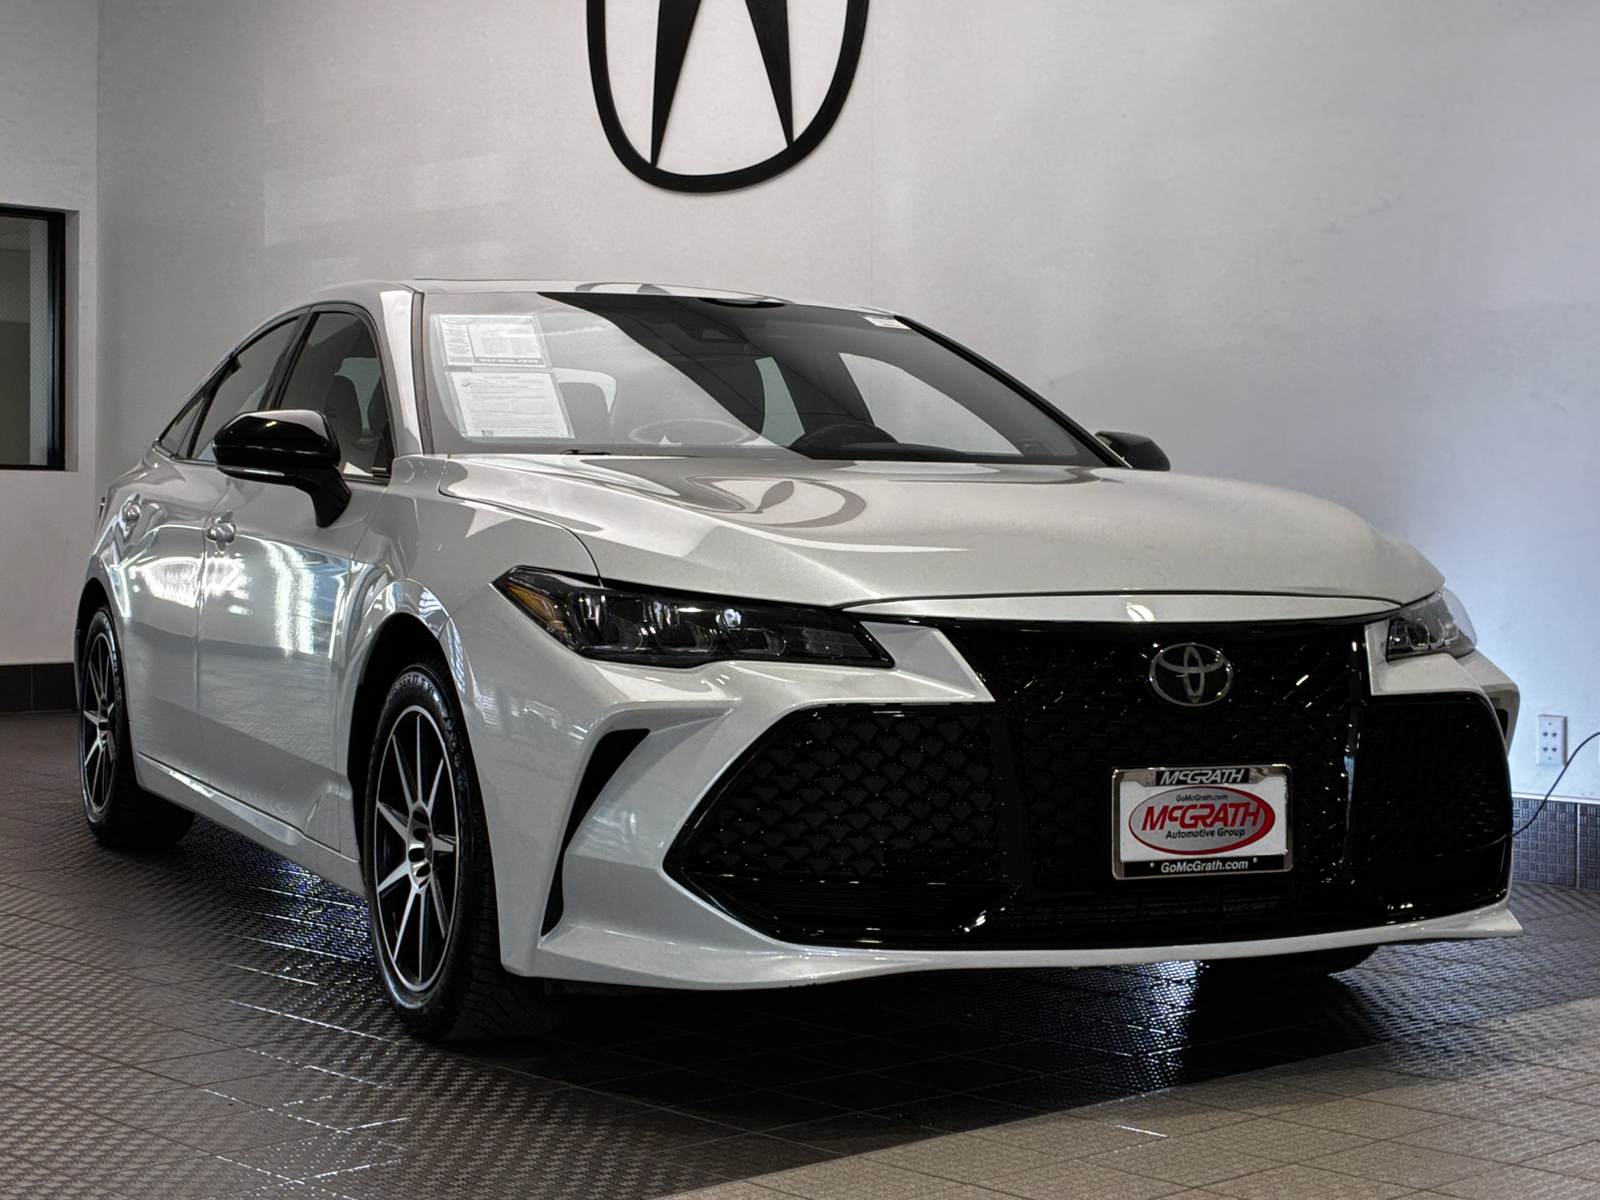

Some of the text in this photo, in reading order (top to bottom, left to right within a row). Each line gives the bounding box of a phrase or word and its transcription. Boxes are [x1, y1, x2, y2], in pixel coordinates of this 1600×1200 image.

[1176, 794, 1228, 802] GoMcGrath.com
[1166, 828, 1246, 839] Automotive Group
[1161, 860, 1248, 873] GoMcGrath.com
